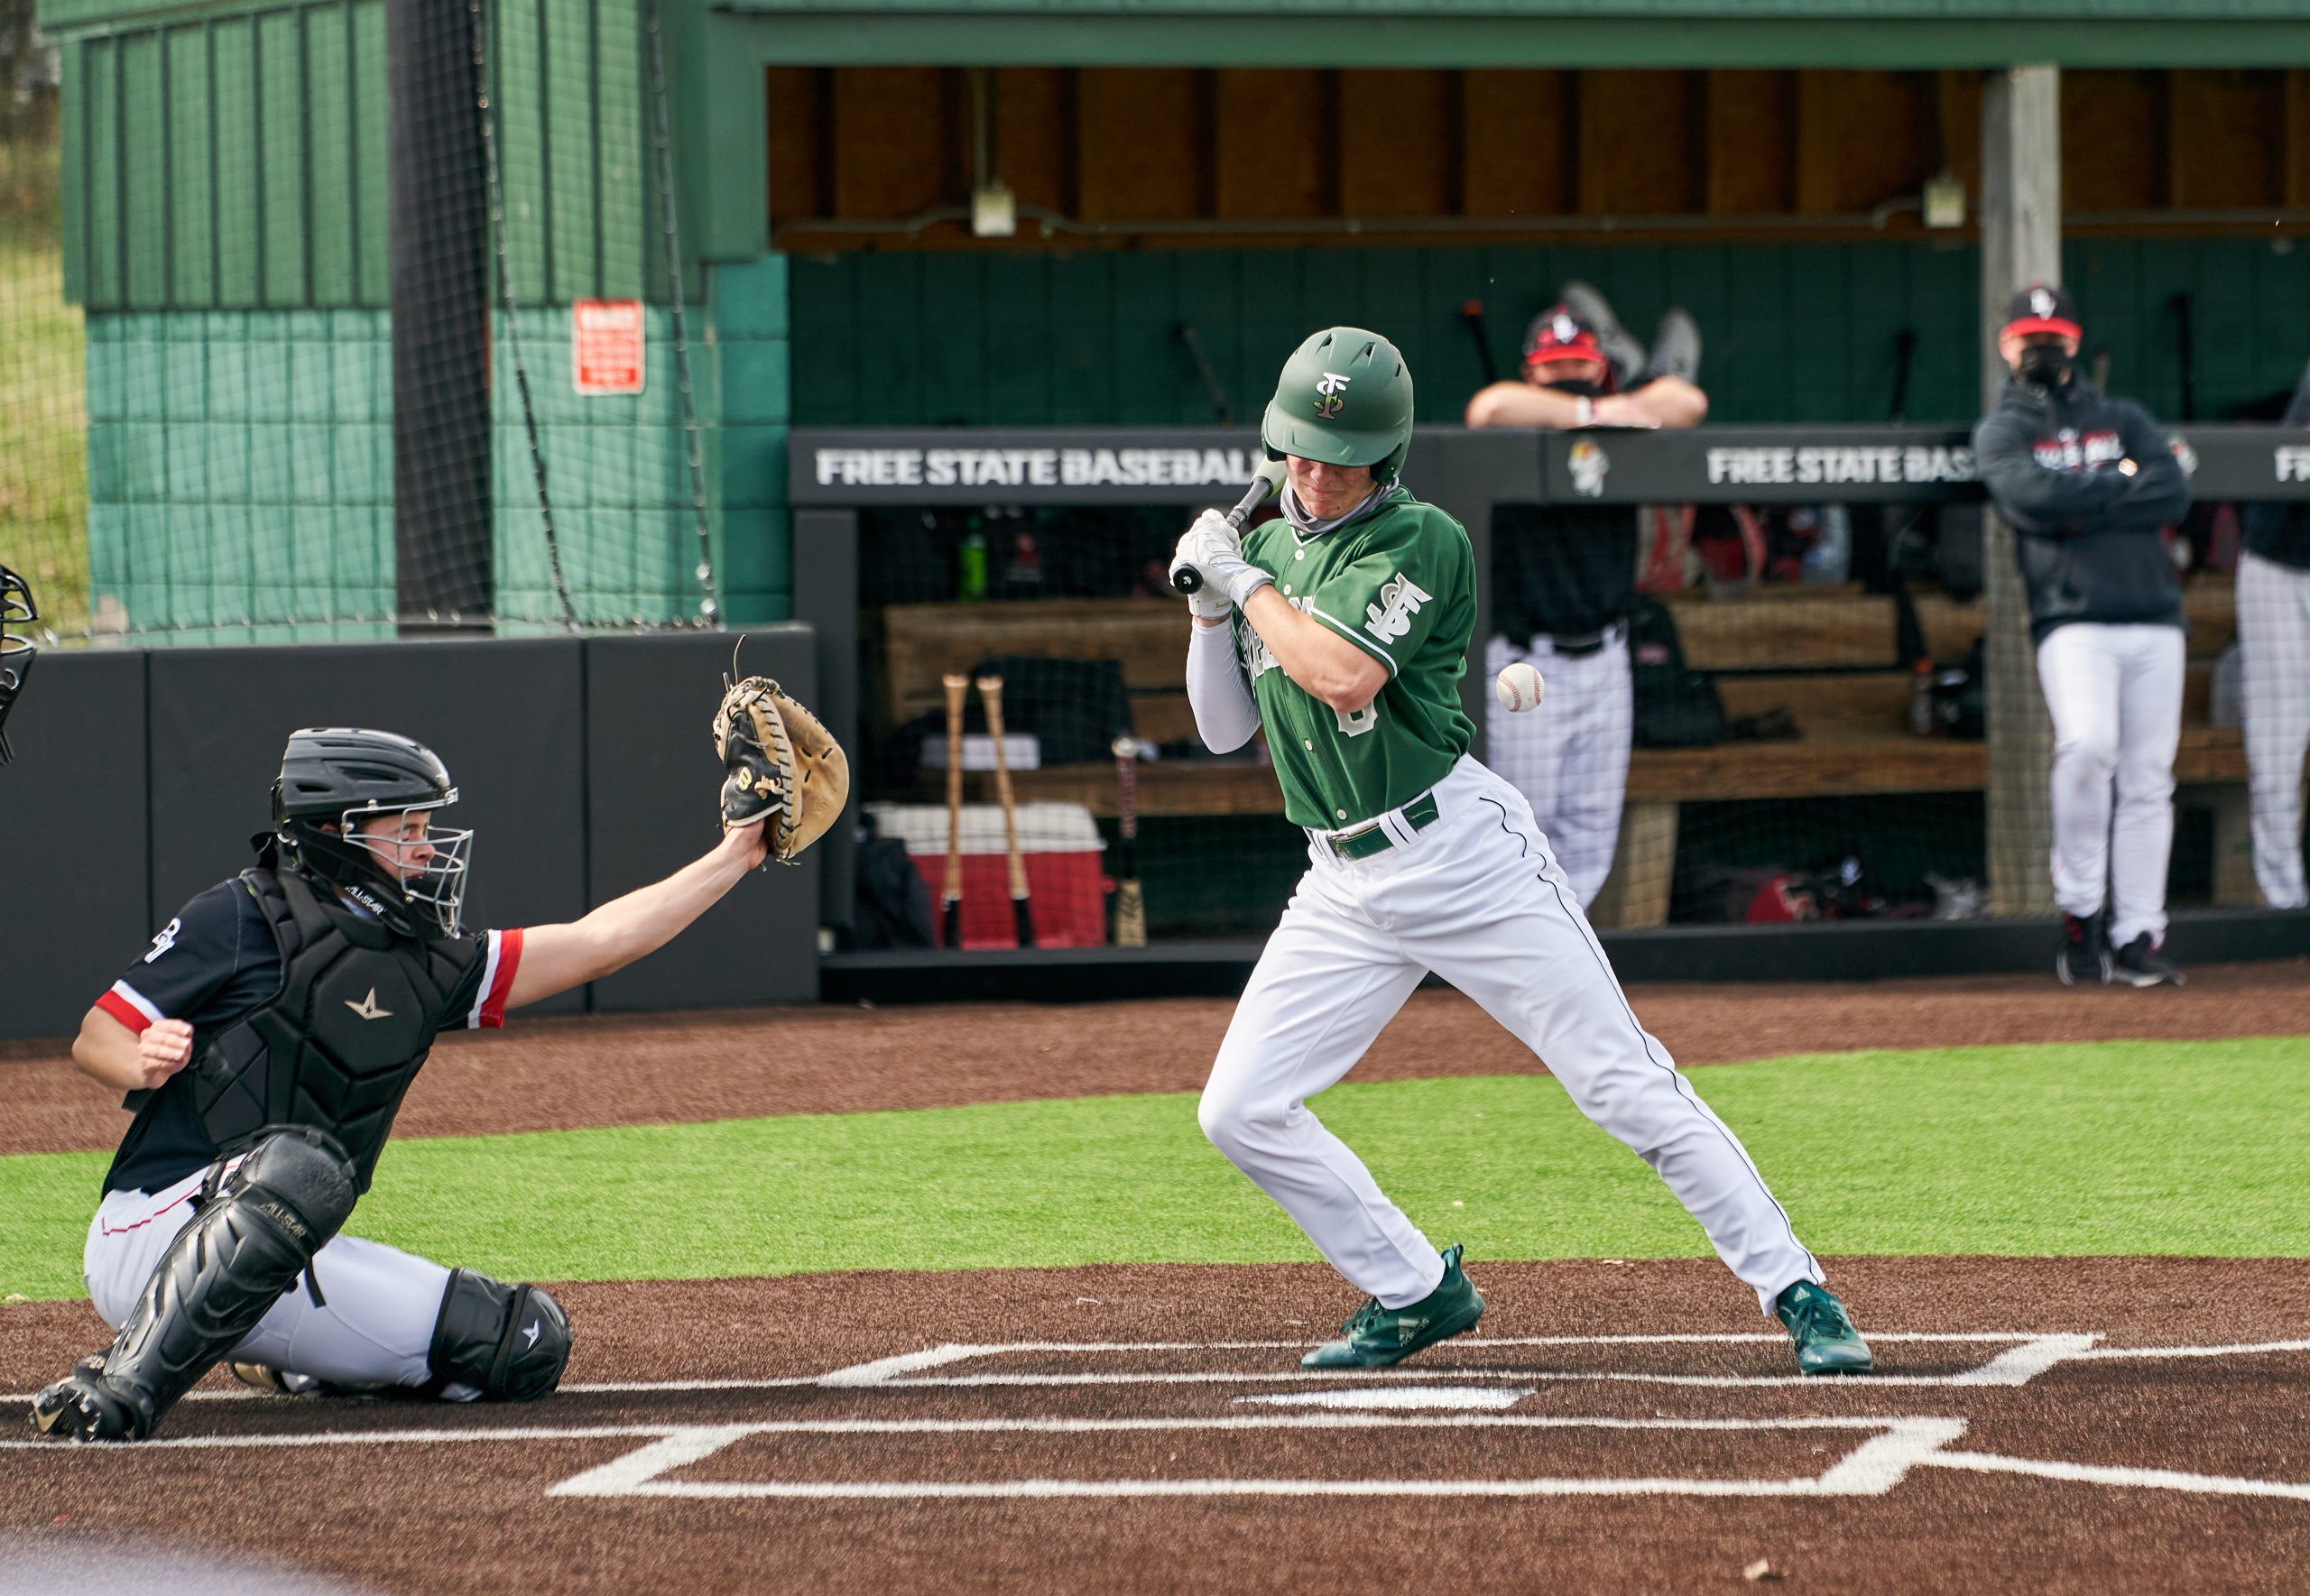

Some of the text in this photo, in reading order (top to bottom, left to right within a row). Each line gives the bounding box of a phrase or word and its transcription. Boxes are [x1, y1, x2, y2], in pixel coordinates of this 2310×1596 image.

[815, 448, 923, 485] FREE
[926, 448, 1058, 485] STATE
[1707, 447, 1795, 484] FREE
[1797, 447, 1901, 483] STATE
